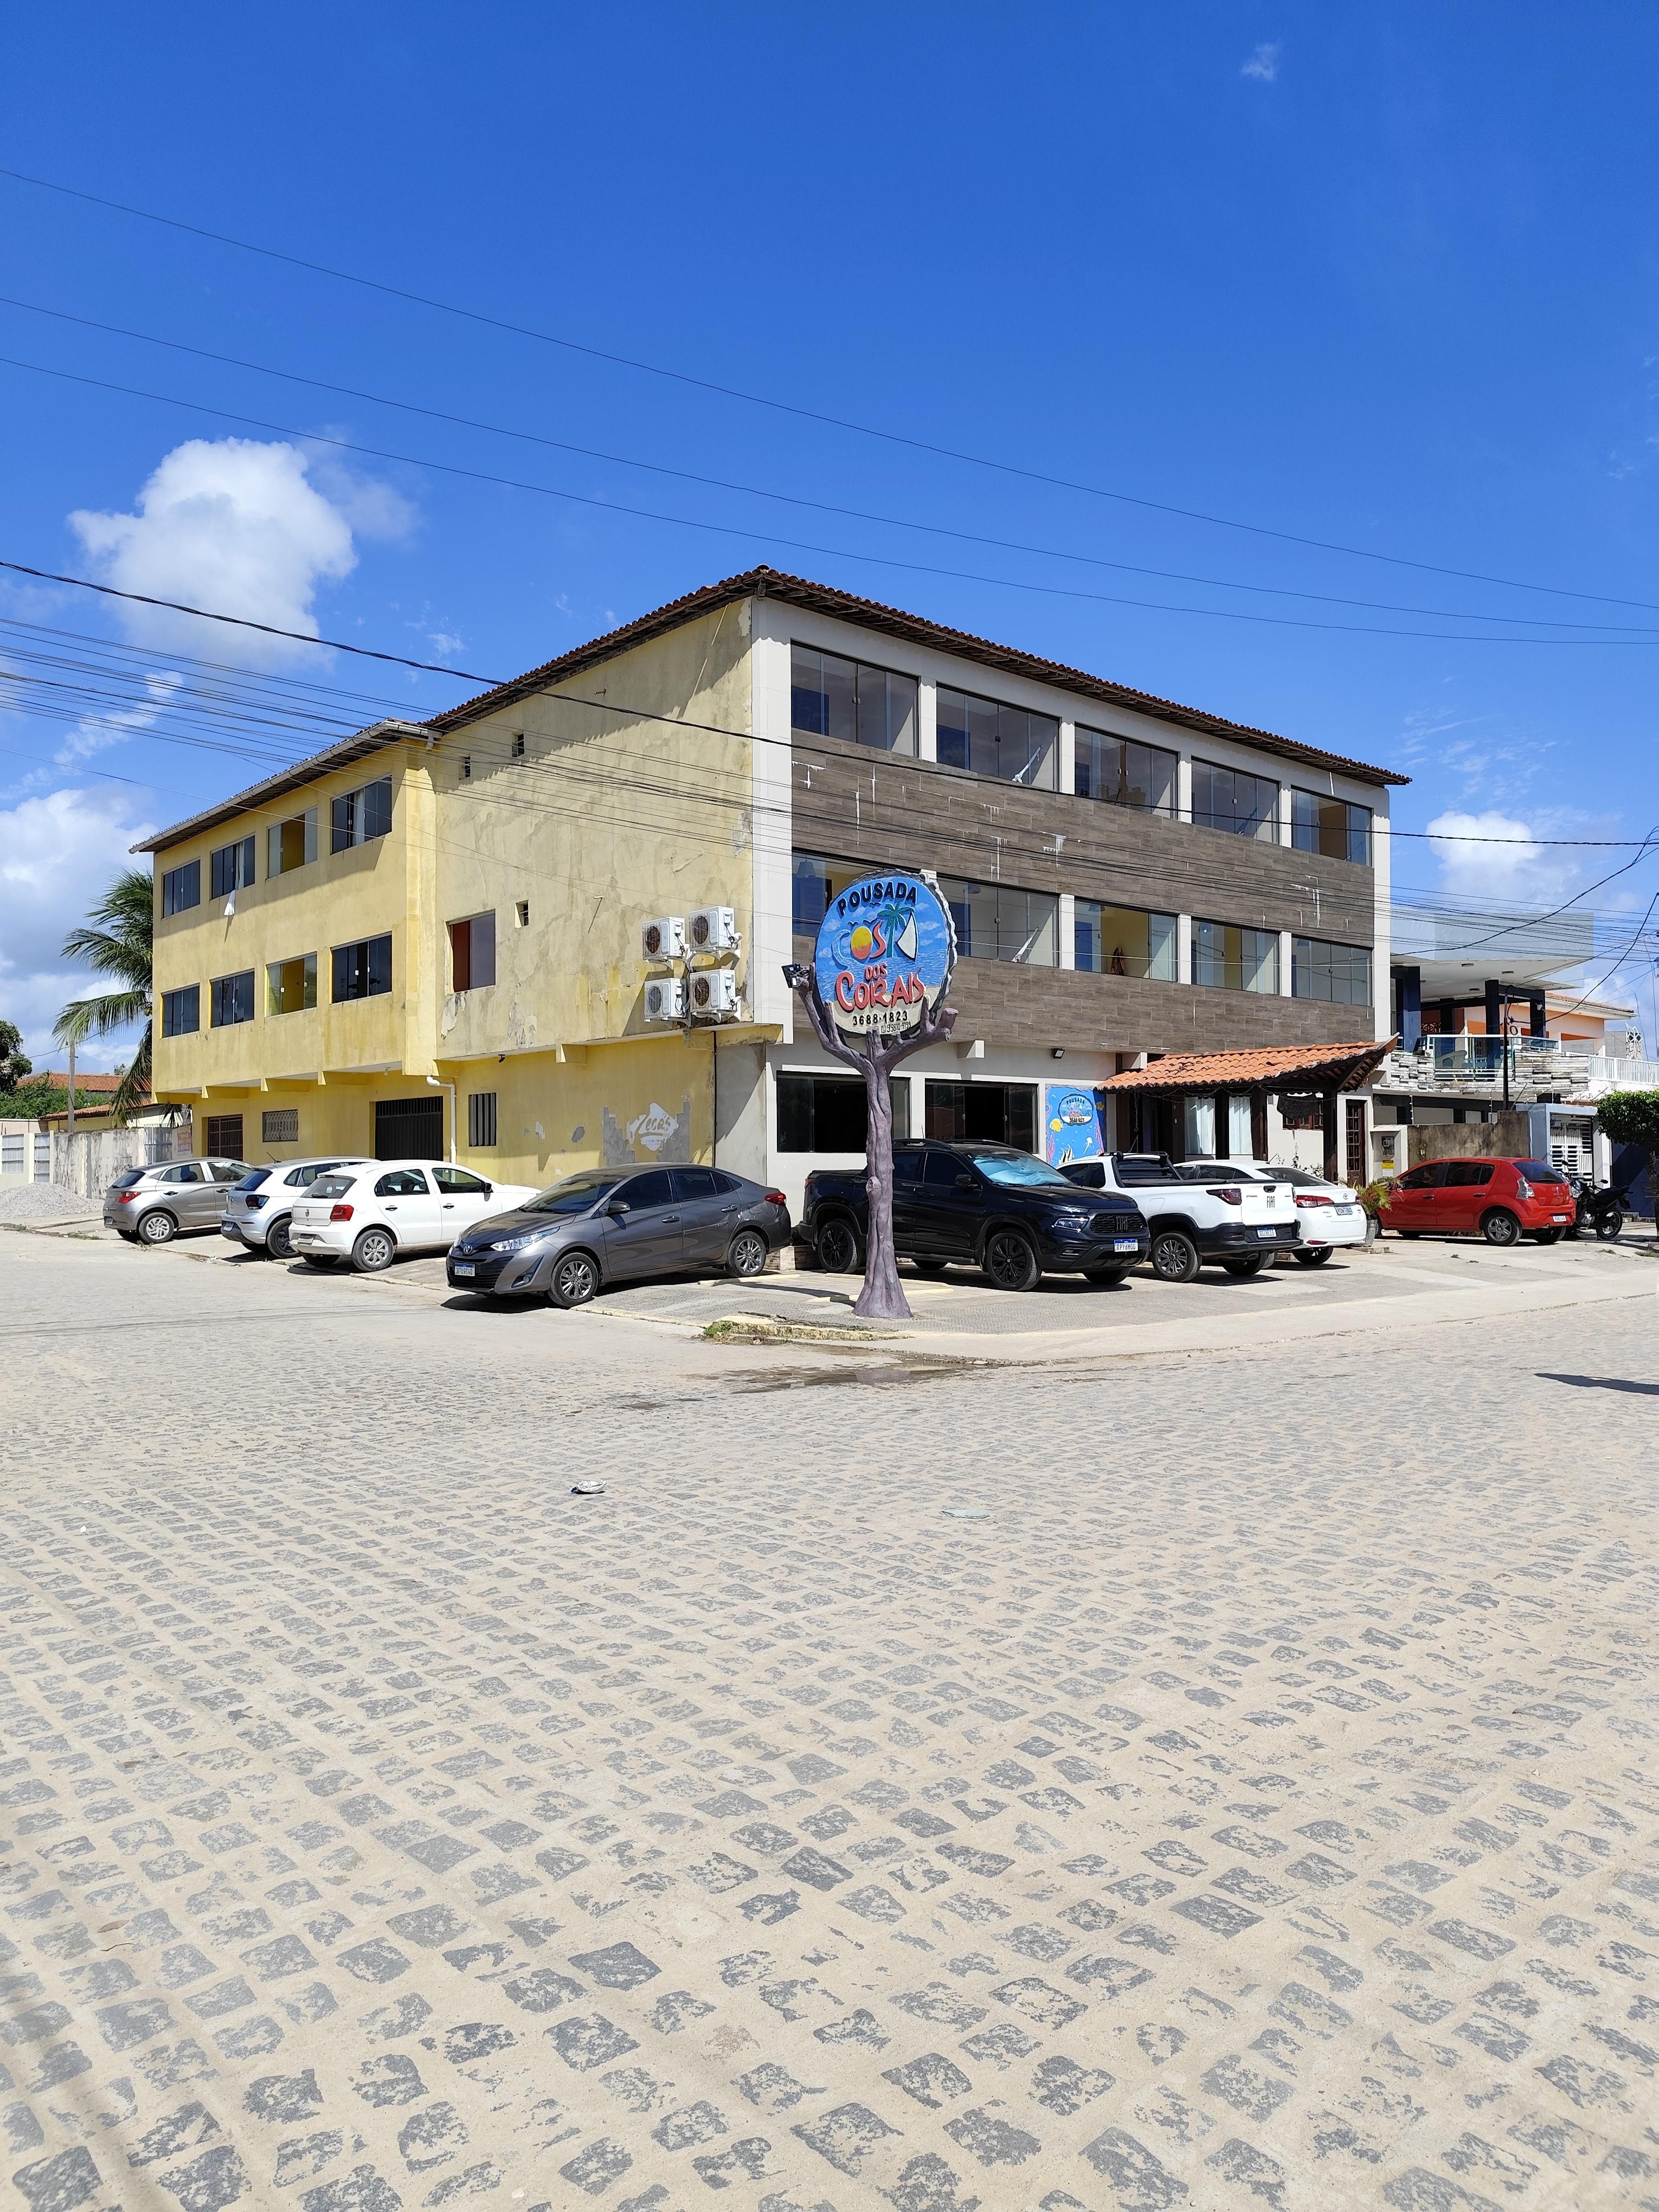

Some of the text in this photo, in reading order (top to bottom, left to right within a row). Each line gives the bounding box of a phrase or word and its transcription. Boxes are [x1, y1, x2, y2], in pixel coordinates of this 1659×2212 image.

[837, 881, 917, 917] POUSADA
[864, 962, 888, 980] DOS
[1266, 1196, 1275, 1208] FIAT
[1116, 1216, 1128, 1230] FIAT
